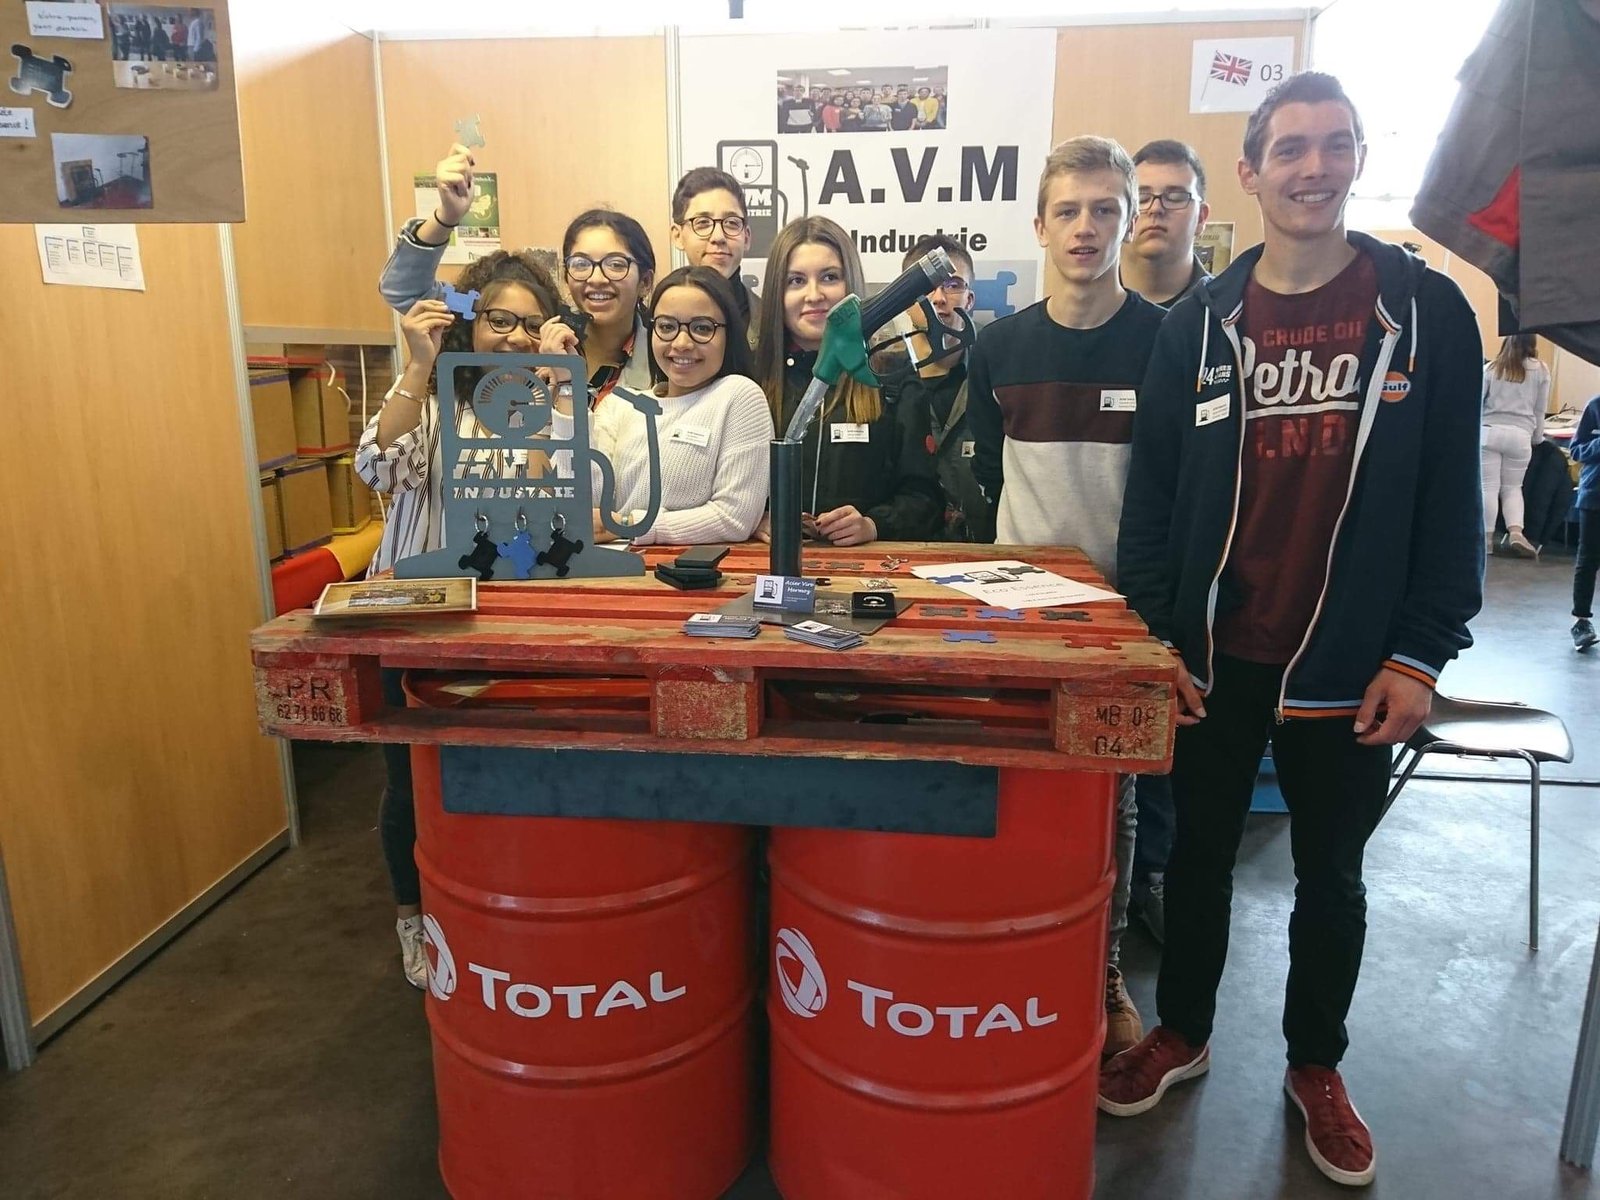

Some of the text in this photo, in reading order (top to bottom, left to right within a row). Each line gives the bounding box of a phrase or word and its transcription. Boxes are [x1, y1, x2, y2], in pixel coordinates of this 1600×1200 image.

[1260, 64, 1283, 82] 03
[818, 145, 1019, 205] A.V.M
[1263, 321, 1364, 347] CRUDE OIL
[452, 448, 576, 480] AVM
[453, 486, 576, 499] INDUSTRIE
[1095, 705, 1121, 727] MB
